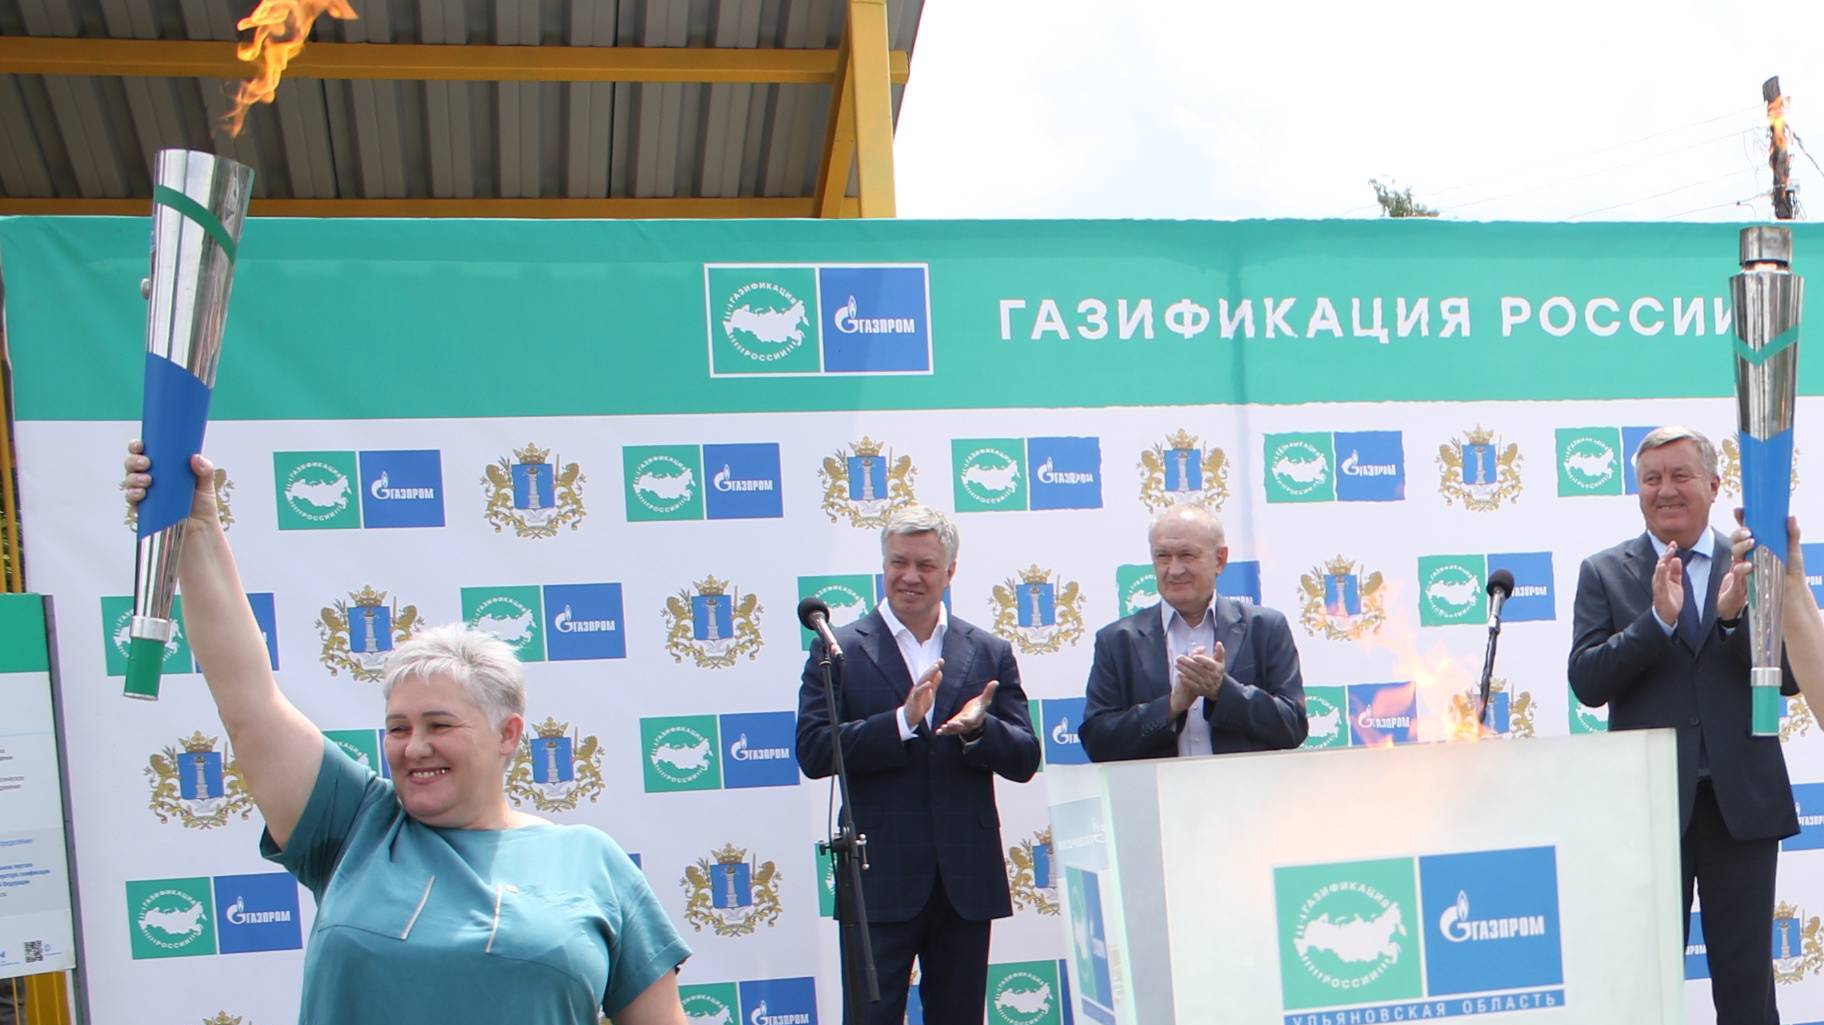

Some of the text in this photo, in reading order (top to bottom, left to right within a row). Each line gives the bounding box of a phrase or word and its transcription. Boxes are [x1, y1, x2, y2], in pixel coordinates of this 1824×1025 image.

[729, 282, 798, 306] ГАЗИФИКАЦИЯ
[859, 318, 916, 334] ГАЗПРОМ
[999, 297, 1472, 345] ГАЗИФИКАЦИЯ
[744, 347, 789, 361] РОССИИ
[391, 487, 434, 500] ГАЗПРОМ
[1302, 881, 1390, 913] ГАЗИФИКАЦИЯ
[246, 910, 291, 924] ГАЗПРОМ
[1471, 915, 1546, 942] ГАЗПРОМ
[1321, 968, 1382, 990] РОССИИ
[1462, 992, 1557, 1016] ОБЛАСТЬ
